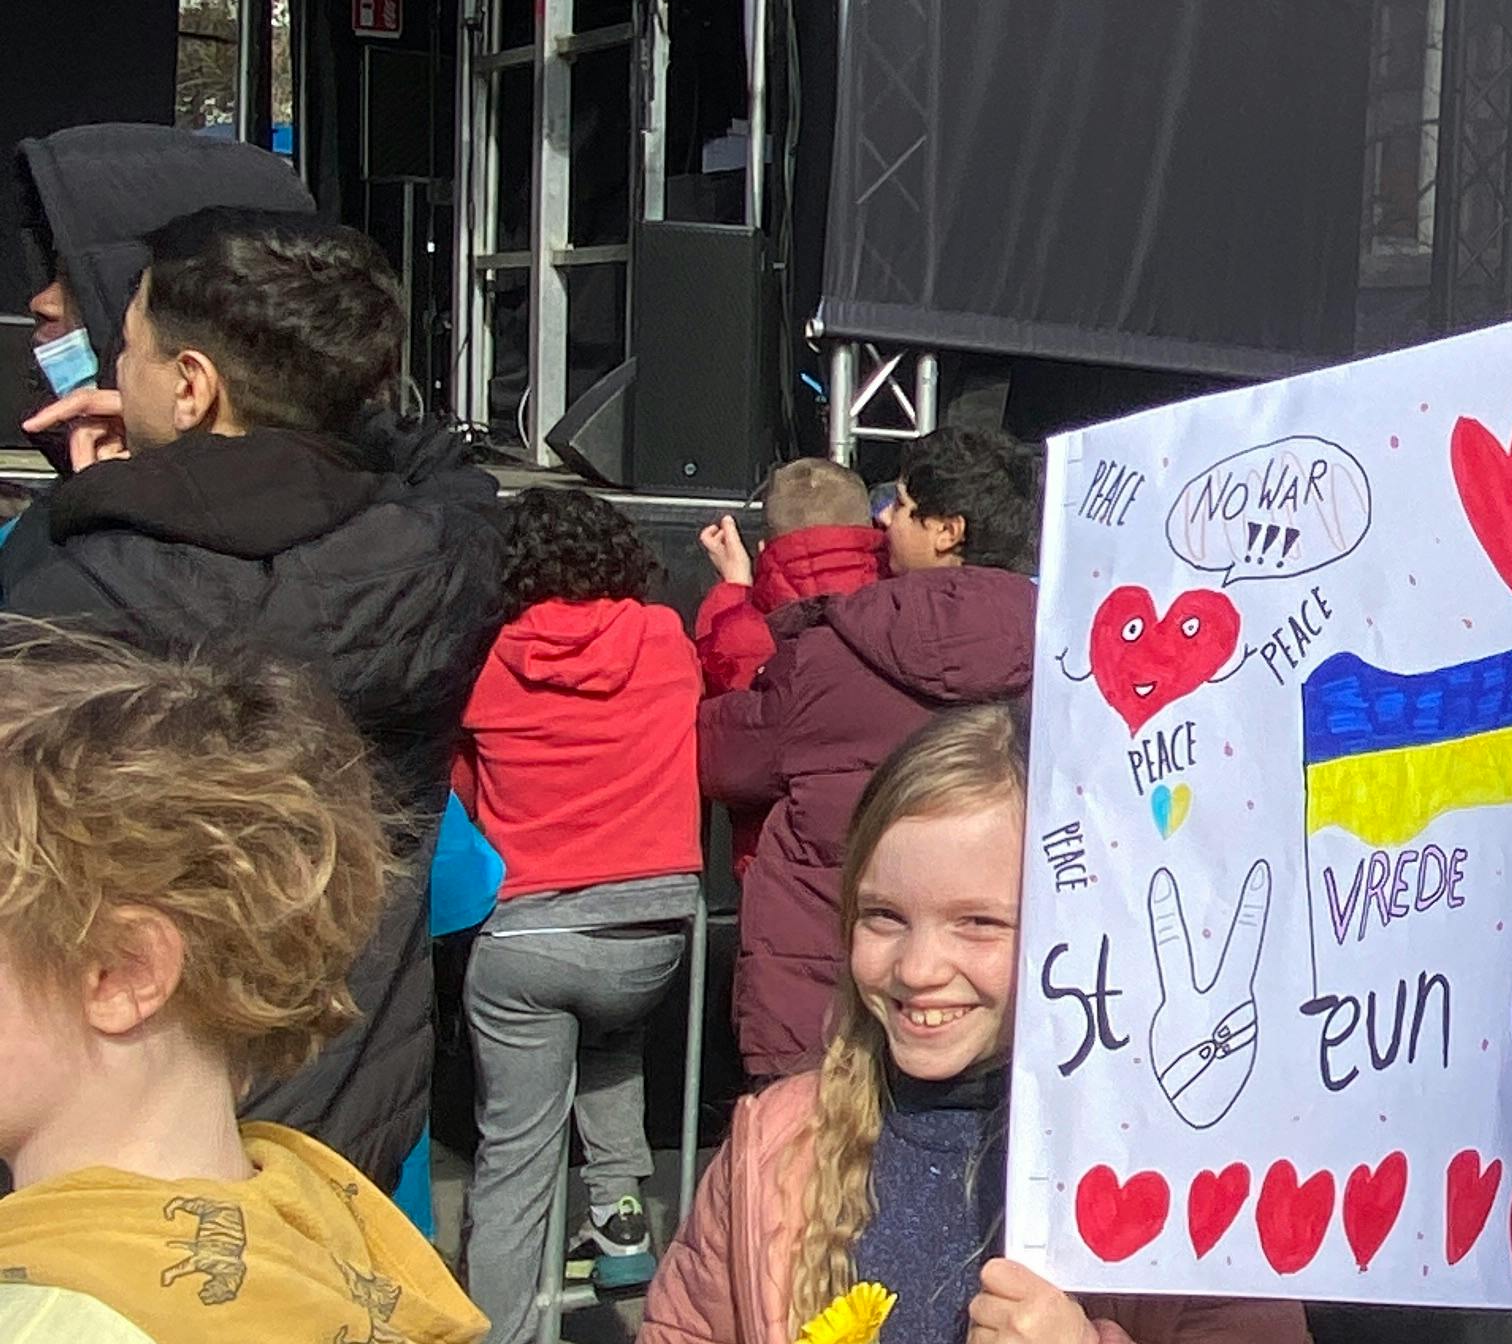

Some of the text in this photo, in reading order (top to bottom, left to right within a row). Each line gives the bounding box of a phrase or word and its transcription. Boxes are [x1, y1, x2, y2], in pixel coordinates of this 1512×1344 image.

[1078, 459, 1146, 526] PEACE
[1190, 457, 1328, 523] NO WAR
[1260, 586, 1333, 686] PEACE
[1127, 721, 1198, 796] PEACE
[1041, 821, 1089, 894] PEACE
[1323, 844, 1469, 946] VREDE
